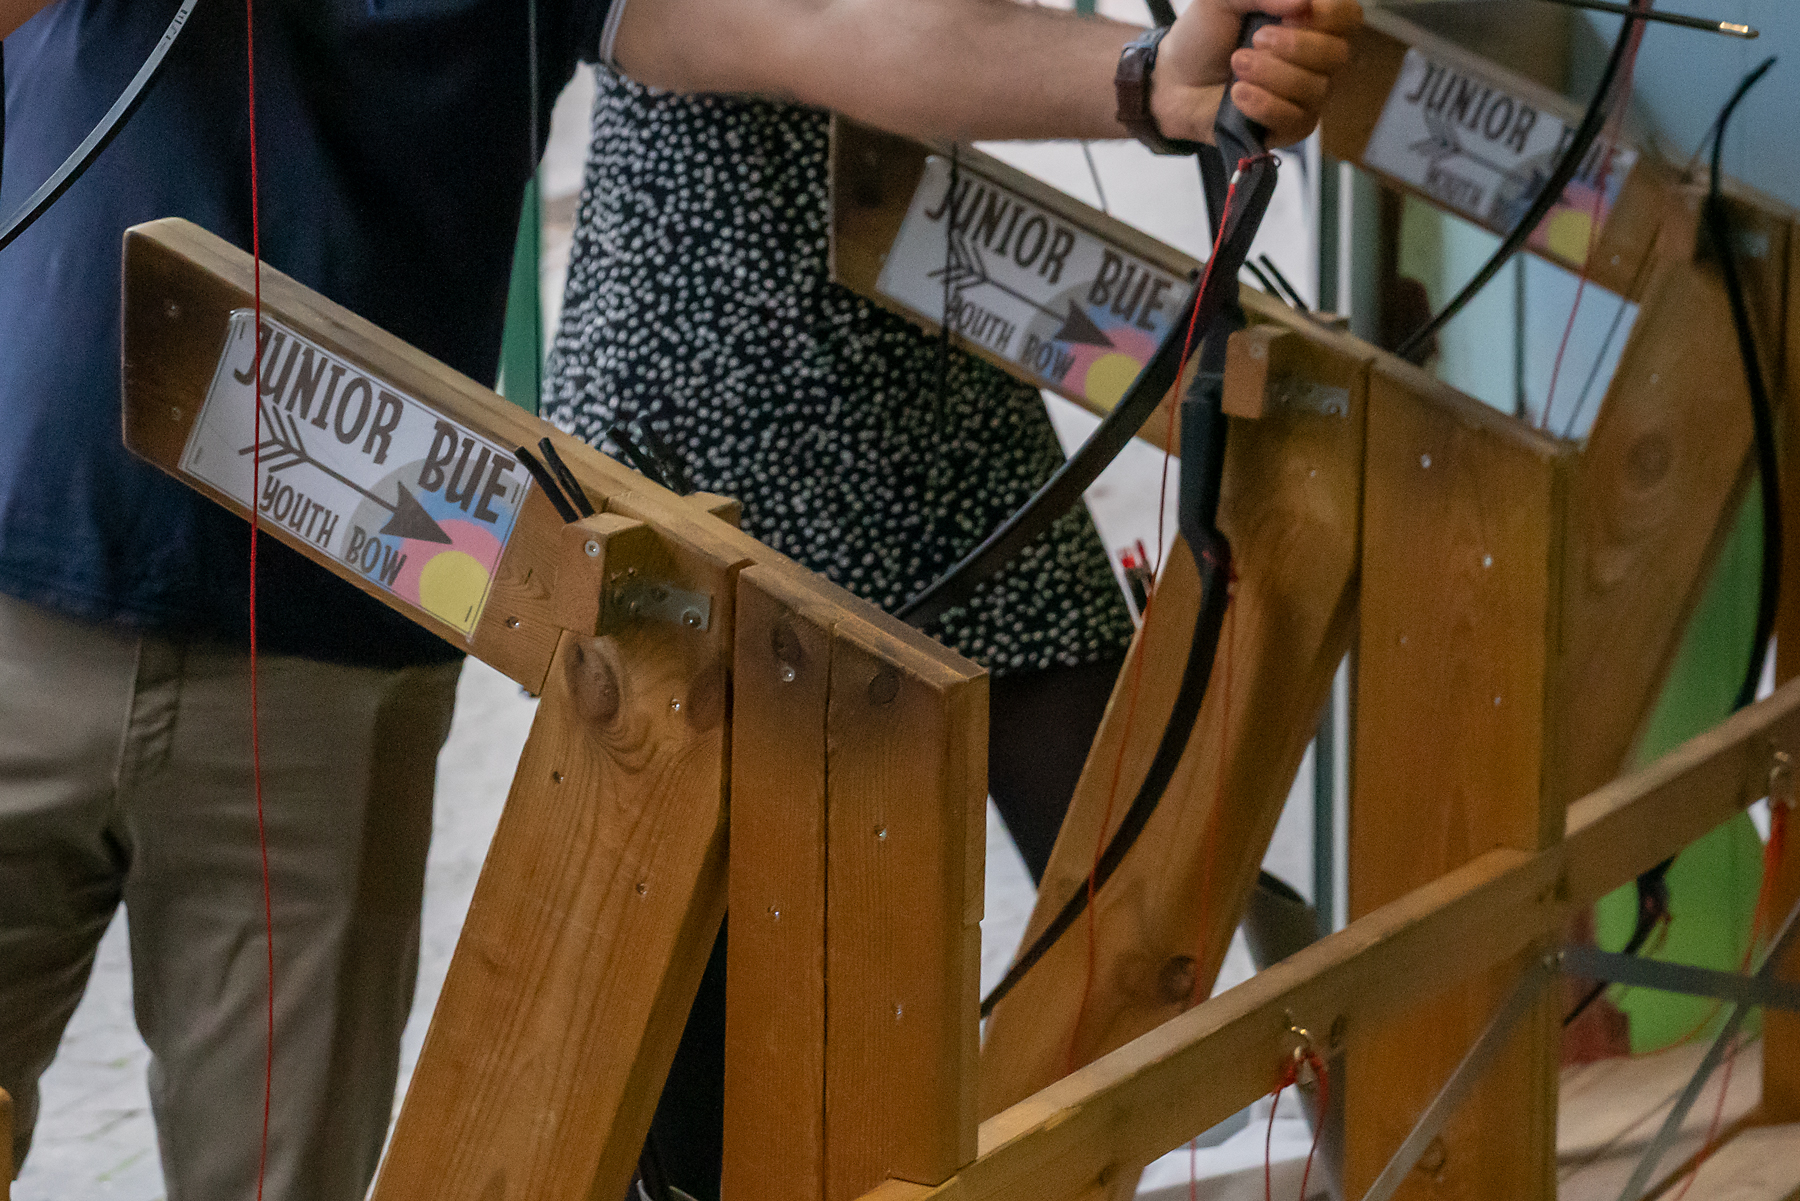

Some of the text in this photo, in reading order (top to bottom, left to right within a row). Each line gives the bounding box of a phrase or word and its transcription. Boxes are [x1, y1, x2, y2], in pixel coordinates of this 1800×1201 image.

[1406, 62, 1537, 155] JUNIOR
[924, 177, 1174, 331] JUNIOR BUE
[233, 322, 517, 524] JUNIOR BUE
[258, 474, 408, 587] YOUTH BOW
